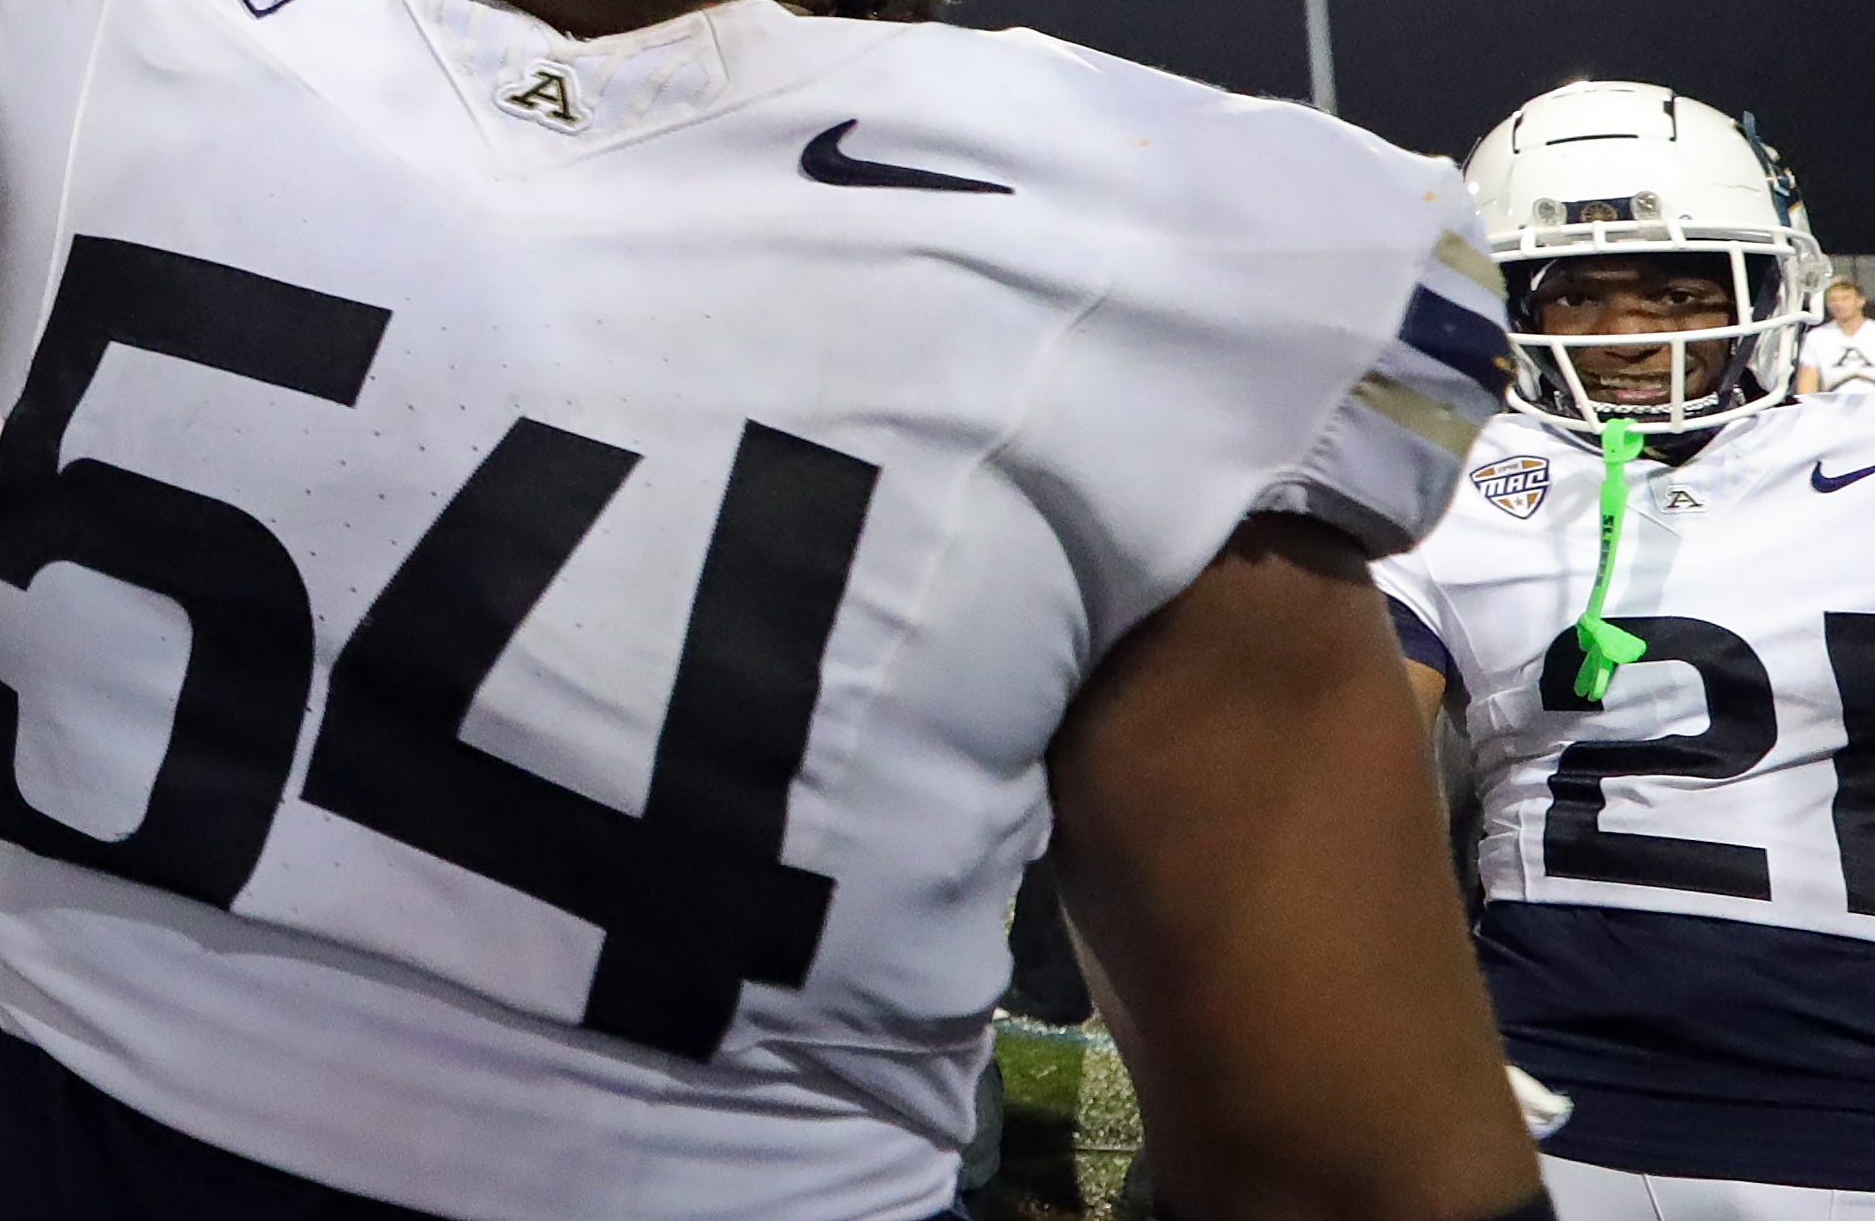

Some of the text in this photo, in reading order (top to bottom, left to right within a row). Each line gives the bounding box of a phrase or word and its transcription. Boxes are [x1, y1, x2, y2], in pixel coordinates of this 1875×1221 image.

[506, 69, 581, 123] A
[1479, 468, 1550, 497] MAC
[1666, 490, 1705, 510] A
